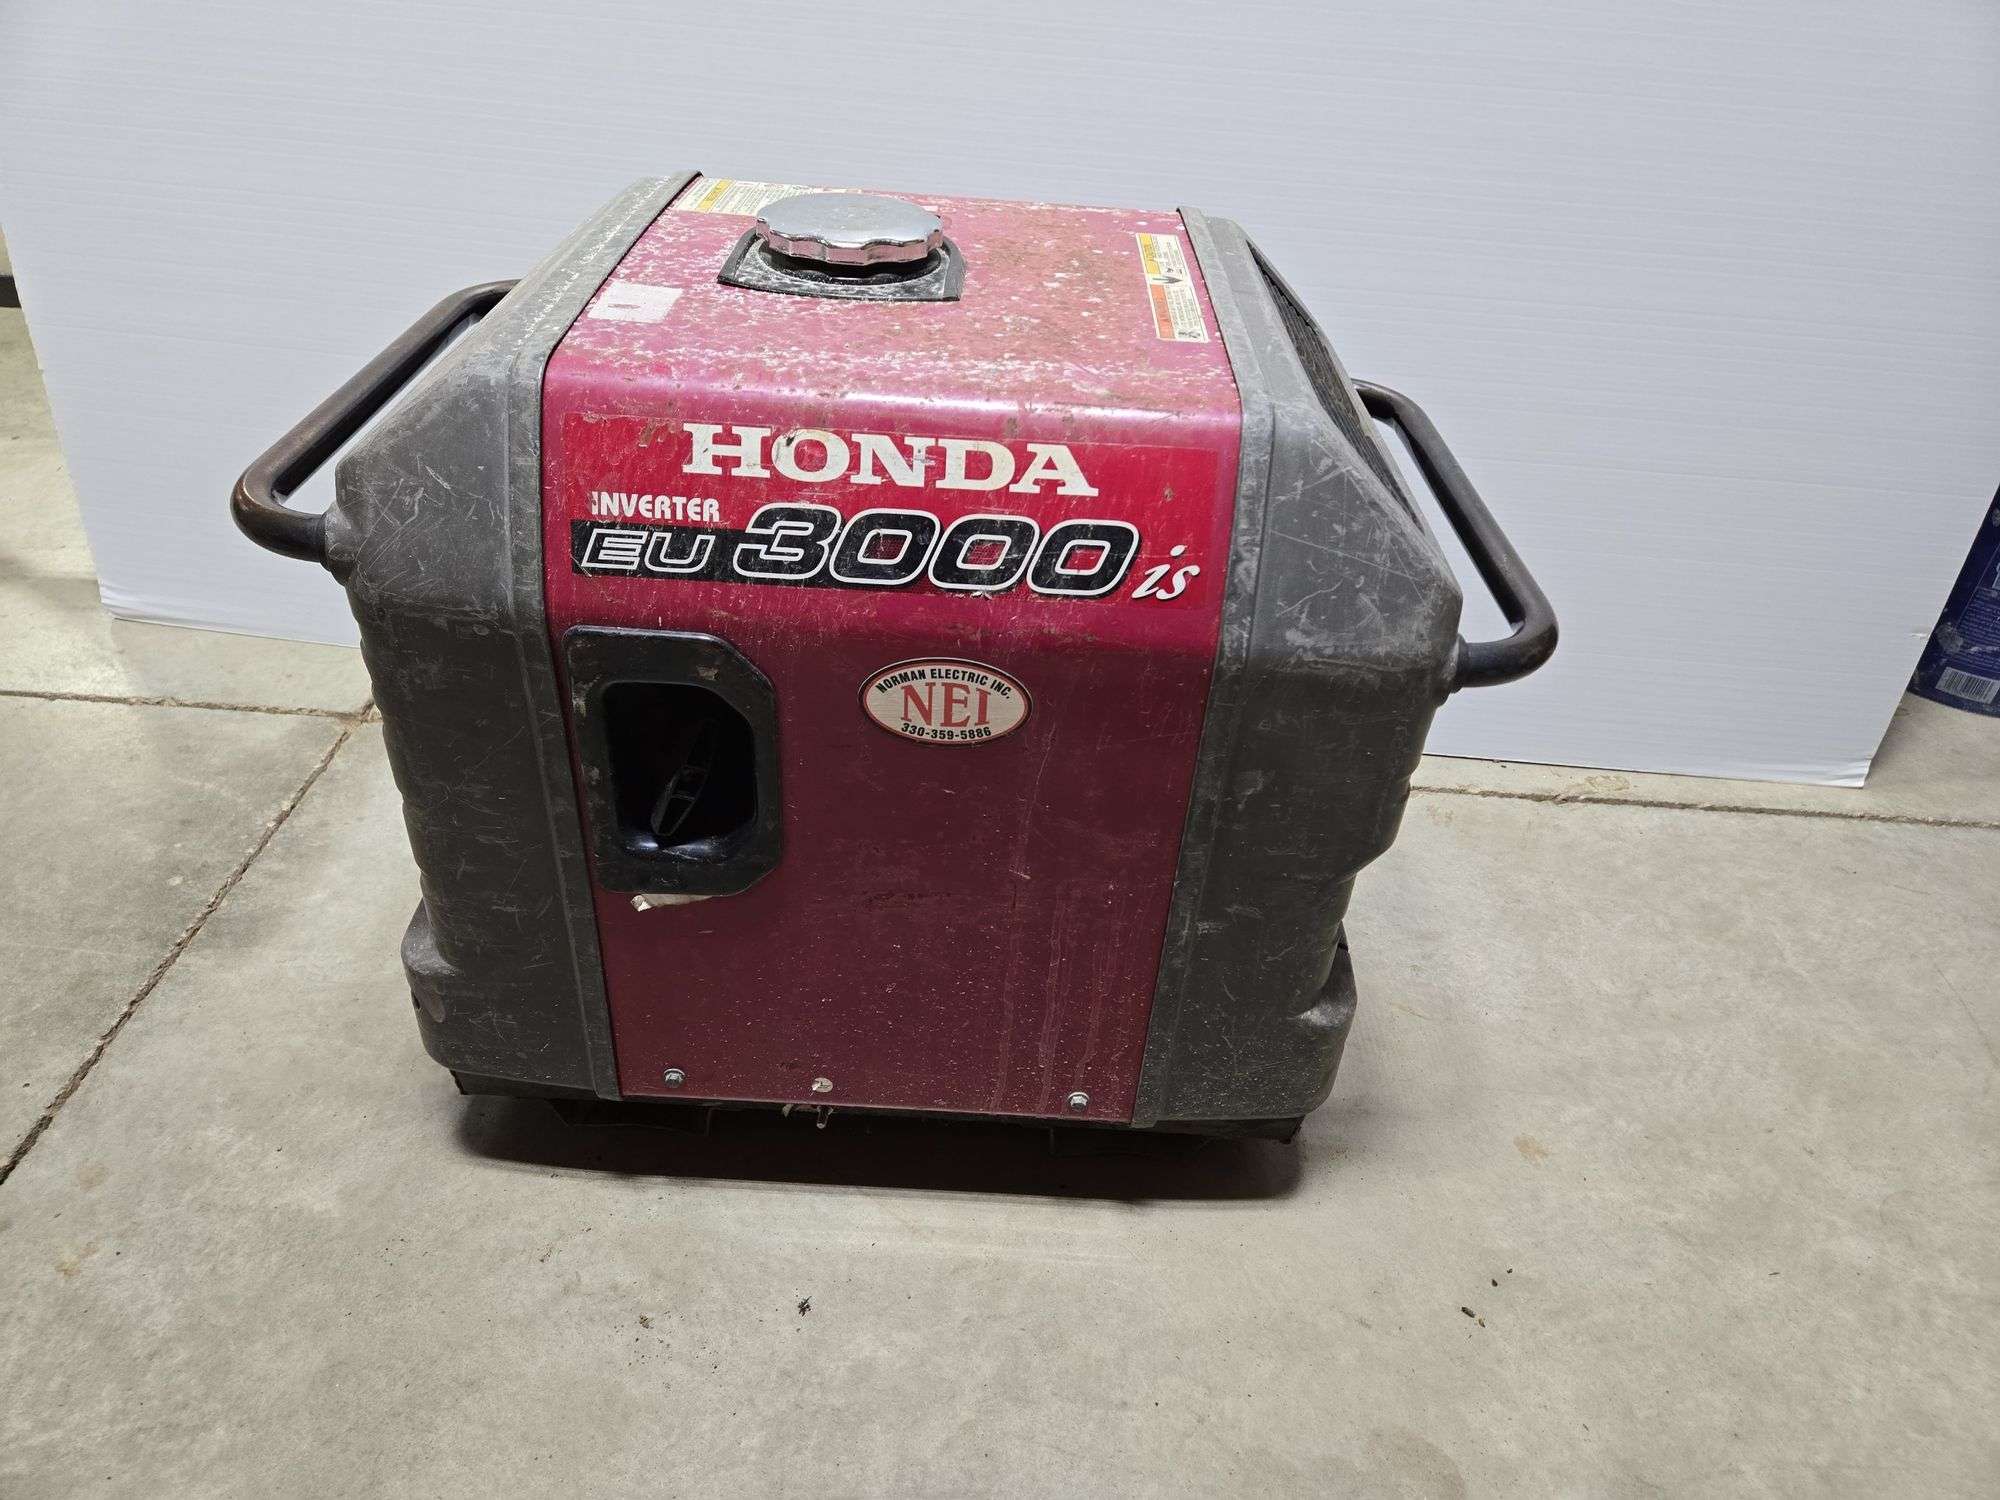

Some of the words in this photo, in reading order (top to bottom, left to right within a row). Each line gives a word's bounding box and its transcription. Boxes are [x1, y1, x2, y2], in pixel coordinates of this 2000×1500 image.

[682, 422, 1099, 496] HONDA
[591, 491, 720, 522] INVERTER
[581, 528, 716, 573] EU
[732, 502, 1140, 596] 3000
[1131, 544, 1200, 599] is
[875, 669, 926, 694] NORMAN
[930, 668, 989, 686] ELECTRIC
[990, 679, 1014, 699] INC.
[900, 682, 991, 728] NEI
[901, 722, 991, 740] 330-359-5886
